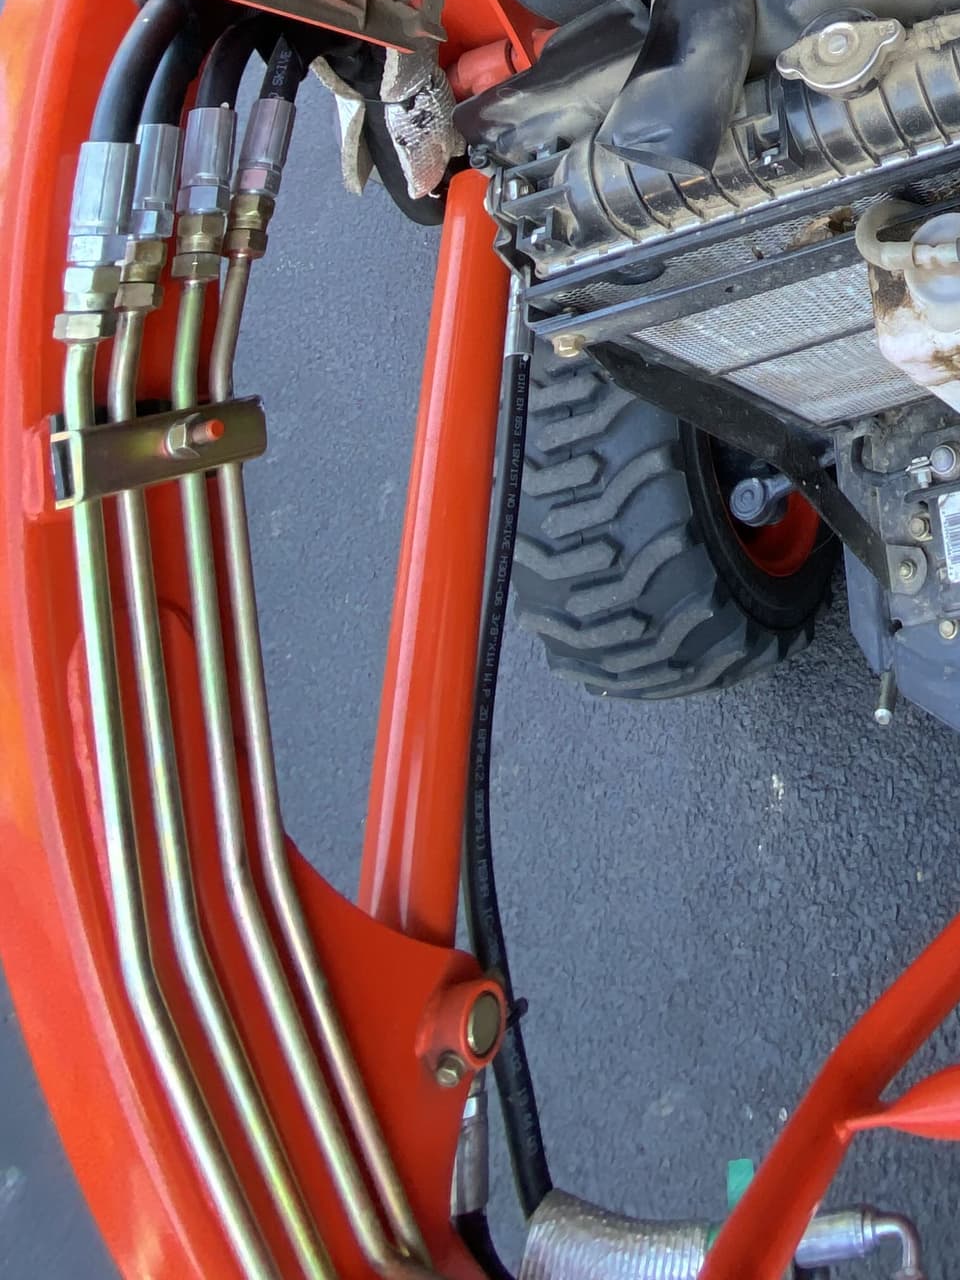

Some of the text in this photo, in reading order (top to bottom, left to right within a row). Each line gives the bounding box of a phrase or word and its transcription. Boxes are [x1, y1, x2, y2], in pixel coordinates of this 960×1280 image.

[516, 373, 525, 393] DIN
[515, 397, 524, 410] EN
[506, 493, 516, 508] NO
[501, 513, 513, 550] SKIVE
